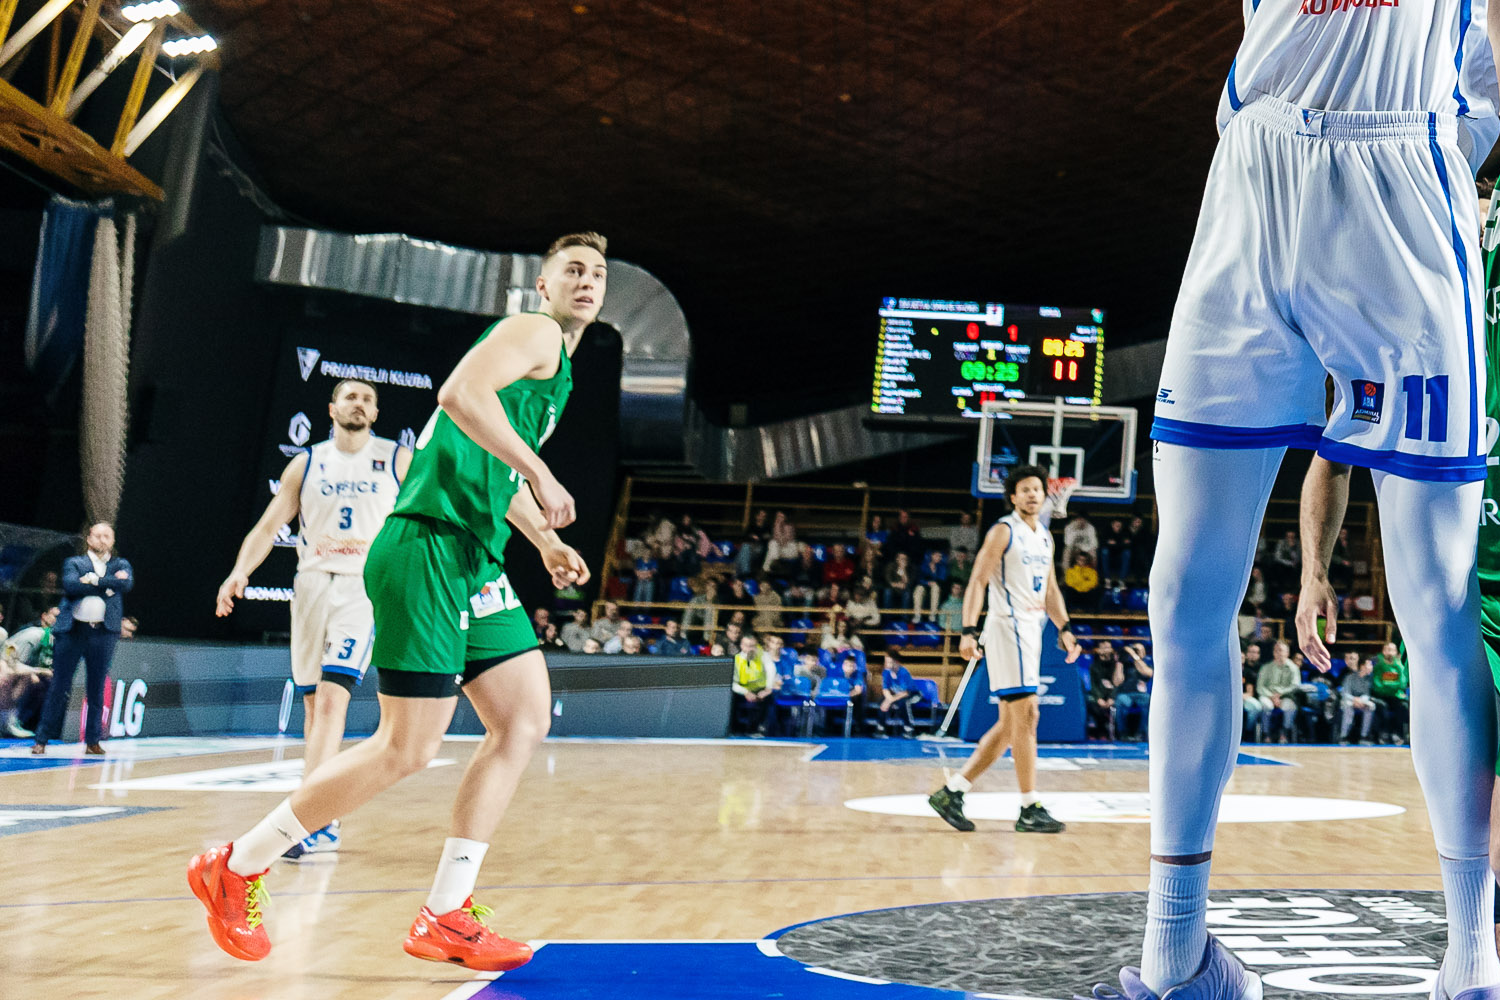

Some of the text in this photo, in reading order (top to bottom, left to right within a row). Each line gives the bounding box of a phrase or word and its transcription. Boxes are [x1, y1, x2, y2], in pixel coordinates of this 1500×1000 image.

[1402, 374, 1449, 443] 11
[339, 506, 353, 530] 3
[337, 638, 356, 660] 3
[109, 678, 148, 737] LG
[1206, 896, 1441, 995] OFFICE
